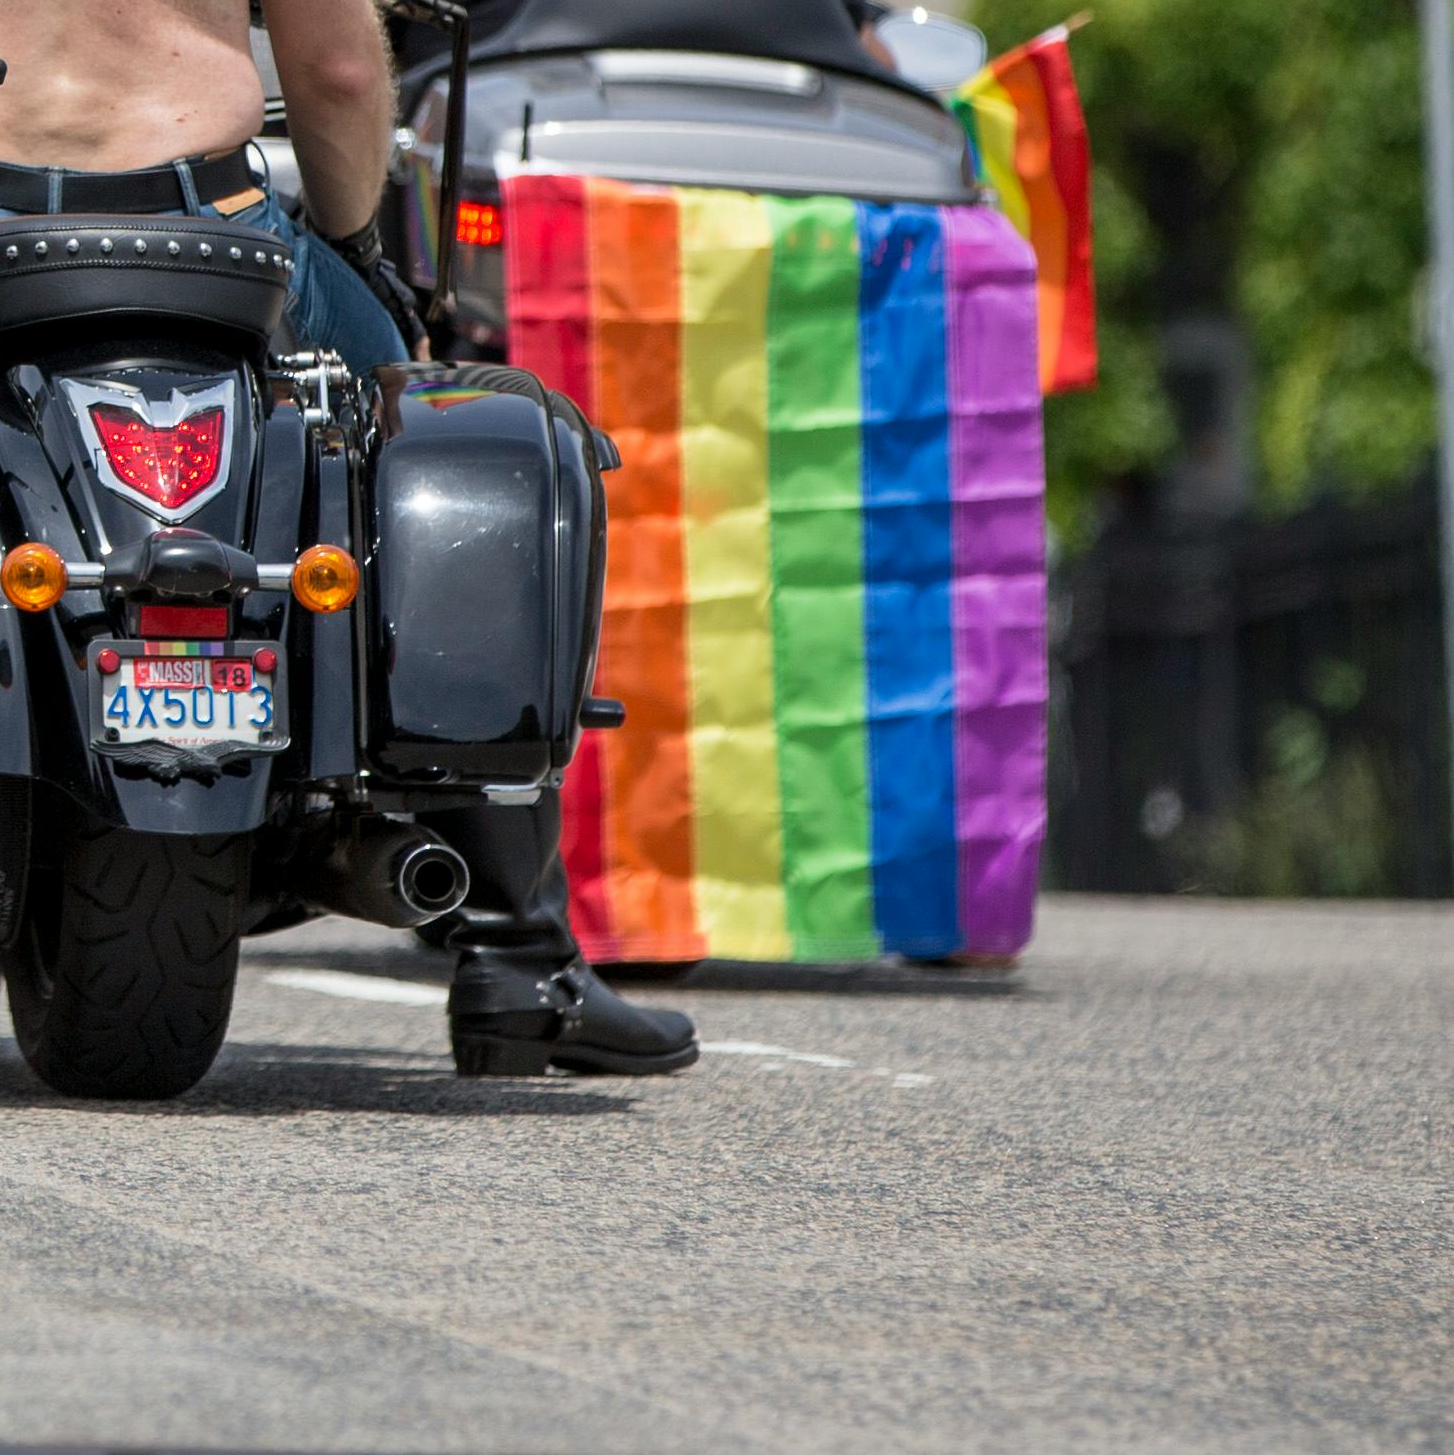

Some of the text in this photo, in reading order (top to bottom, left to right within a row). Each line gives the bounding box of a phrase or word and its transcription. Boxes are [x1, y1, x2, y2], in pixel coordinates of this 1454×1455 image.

[148, 660, 192, 683] MASS
[218, 667, 247, 688] 18
[106, 684, 274, 728] 4X5013
